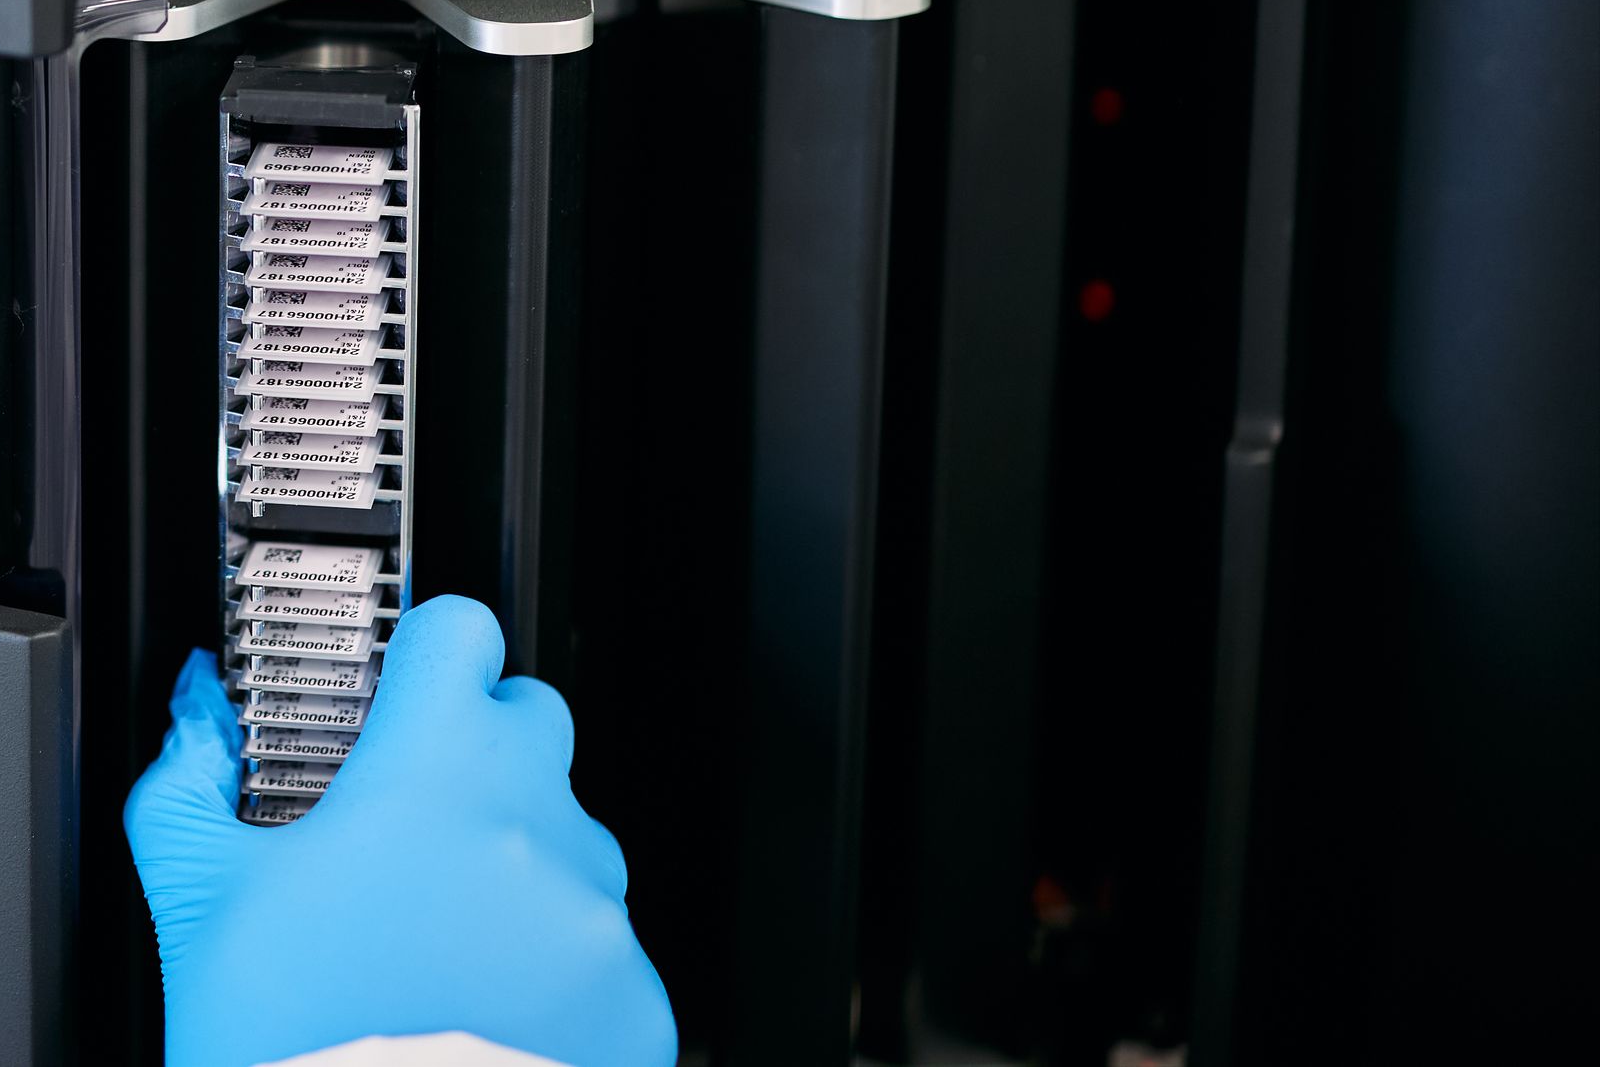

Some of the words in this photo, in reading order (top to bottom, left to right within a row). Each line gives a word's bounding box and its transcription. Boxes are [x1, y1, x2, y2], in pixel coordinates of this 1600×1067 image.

[264, 164, 371, 174] 24H00064969
[260, 202, 367, 212] 24H00066187
[260, 238, 368, 248] 24H00066187
[257, 273, 365, 284] 24H00066187
[258, 310, 364, 321] 24H00066187
[254, 344, 360, 355] 24H00066187
[256, 378, 362, 389] 24H00066187
[259, 416, 366, 428] 24H00066187
[252, 451, 359, 463] 24H00066187
[250, 487, 356, 499] 24H00066187
[252, 570, 357, 583] 24H00066187
[254, 605, 358, 618] 24H00066187
[250, 638, 353, 652] 24H00065939
[253, 675, 356, 688] 24H00065940
[254, 710, 357, 724] 24H00065940
[256, 744, 350, 756] 4H00065941
[260, 778, 330, 789] 00065941
